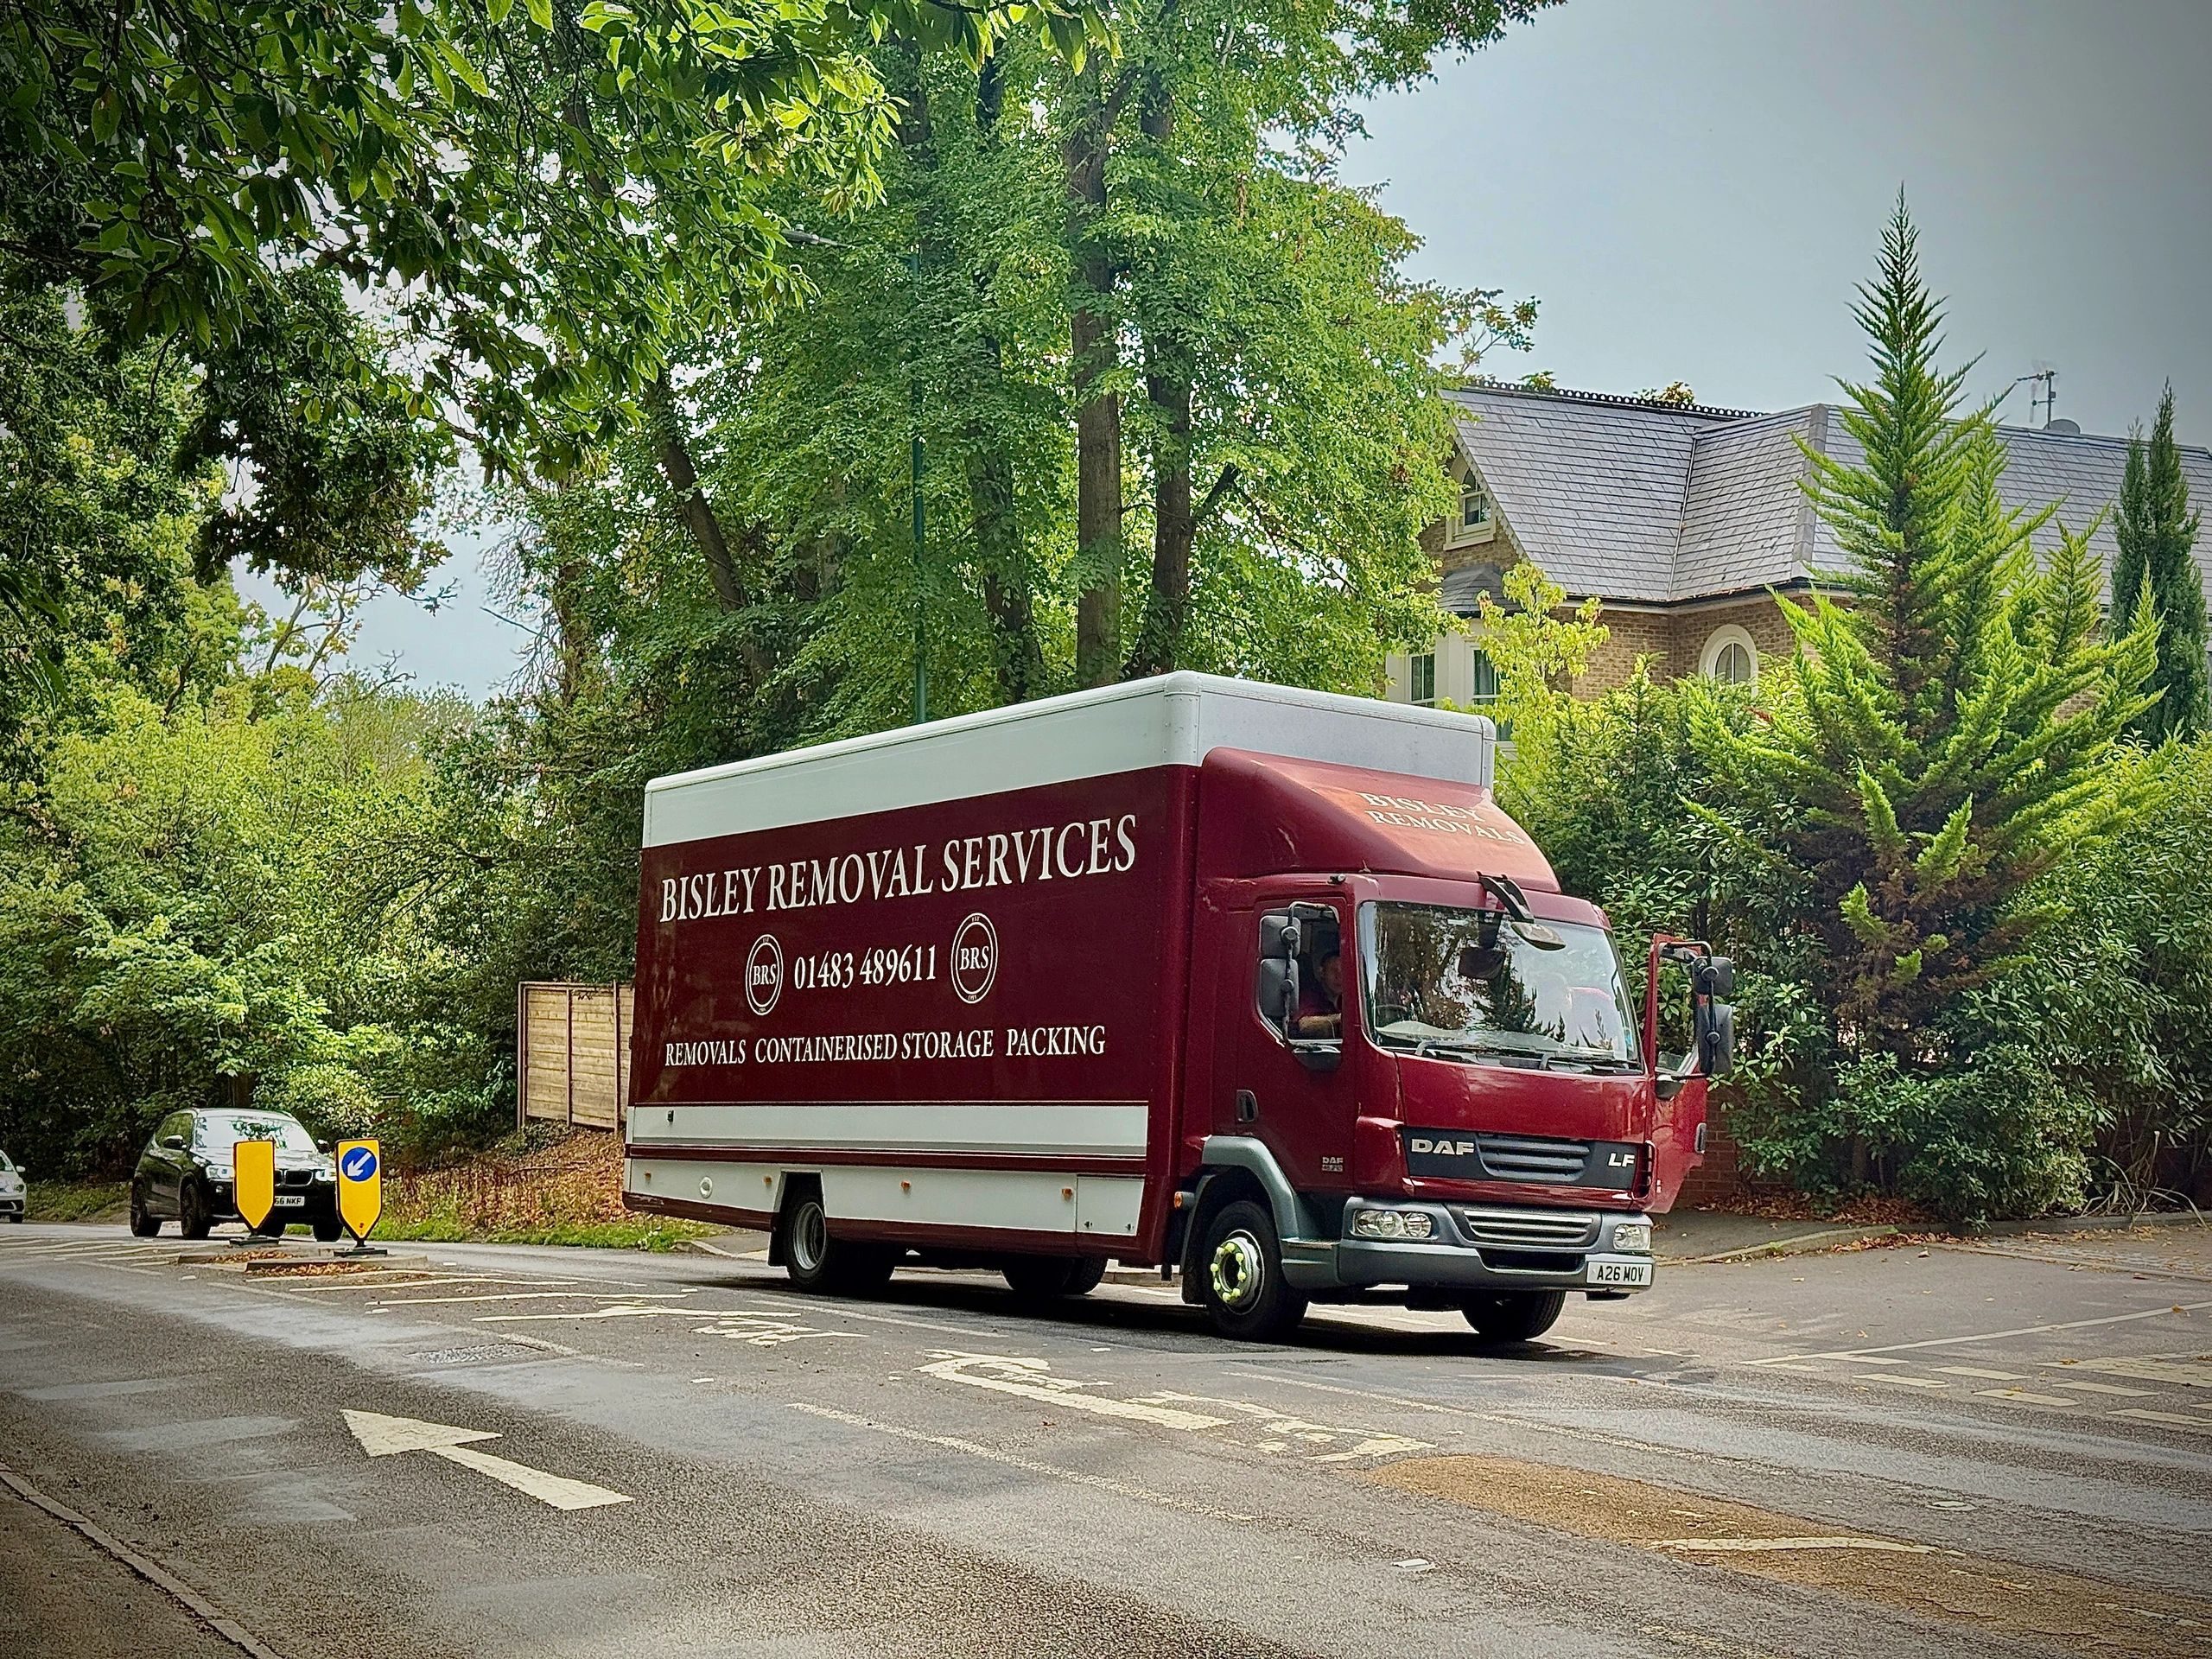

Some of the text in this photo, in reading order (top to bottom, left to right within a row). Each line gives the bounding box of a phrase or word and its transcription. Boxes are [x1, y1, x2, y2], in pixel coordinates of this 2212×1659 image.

[1357, 792, 1485, 823] BISLEY
[1365, 810, 1525, 844] REMOVALS
[659, 814, 1136, 923] BISLEY REMOVAL SERVICES
[794, 944, 936, 989] 01483 489611
[959, 945, 989, 970] BRS
[752, 963, 777, 986] BRS
[664, 1025, 1106, 1067] REMOVALS CONTAINERISED STORAGE PACKING
[1411, 1138, 1475, 1156] DAF
[1607, 1153, 1636, 1167] LF
[1597, 1265, 1644, 1282] A26 MOV
